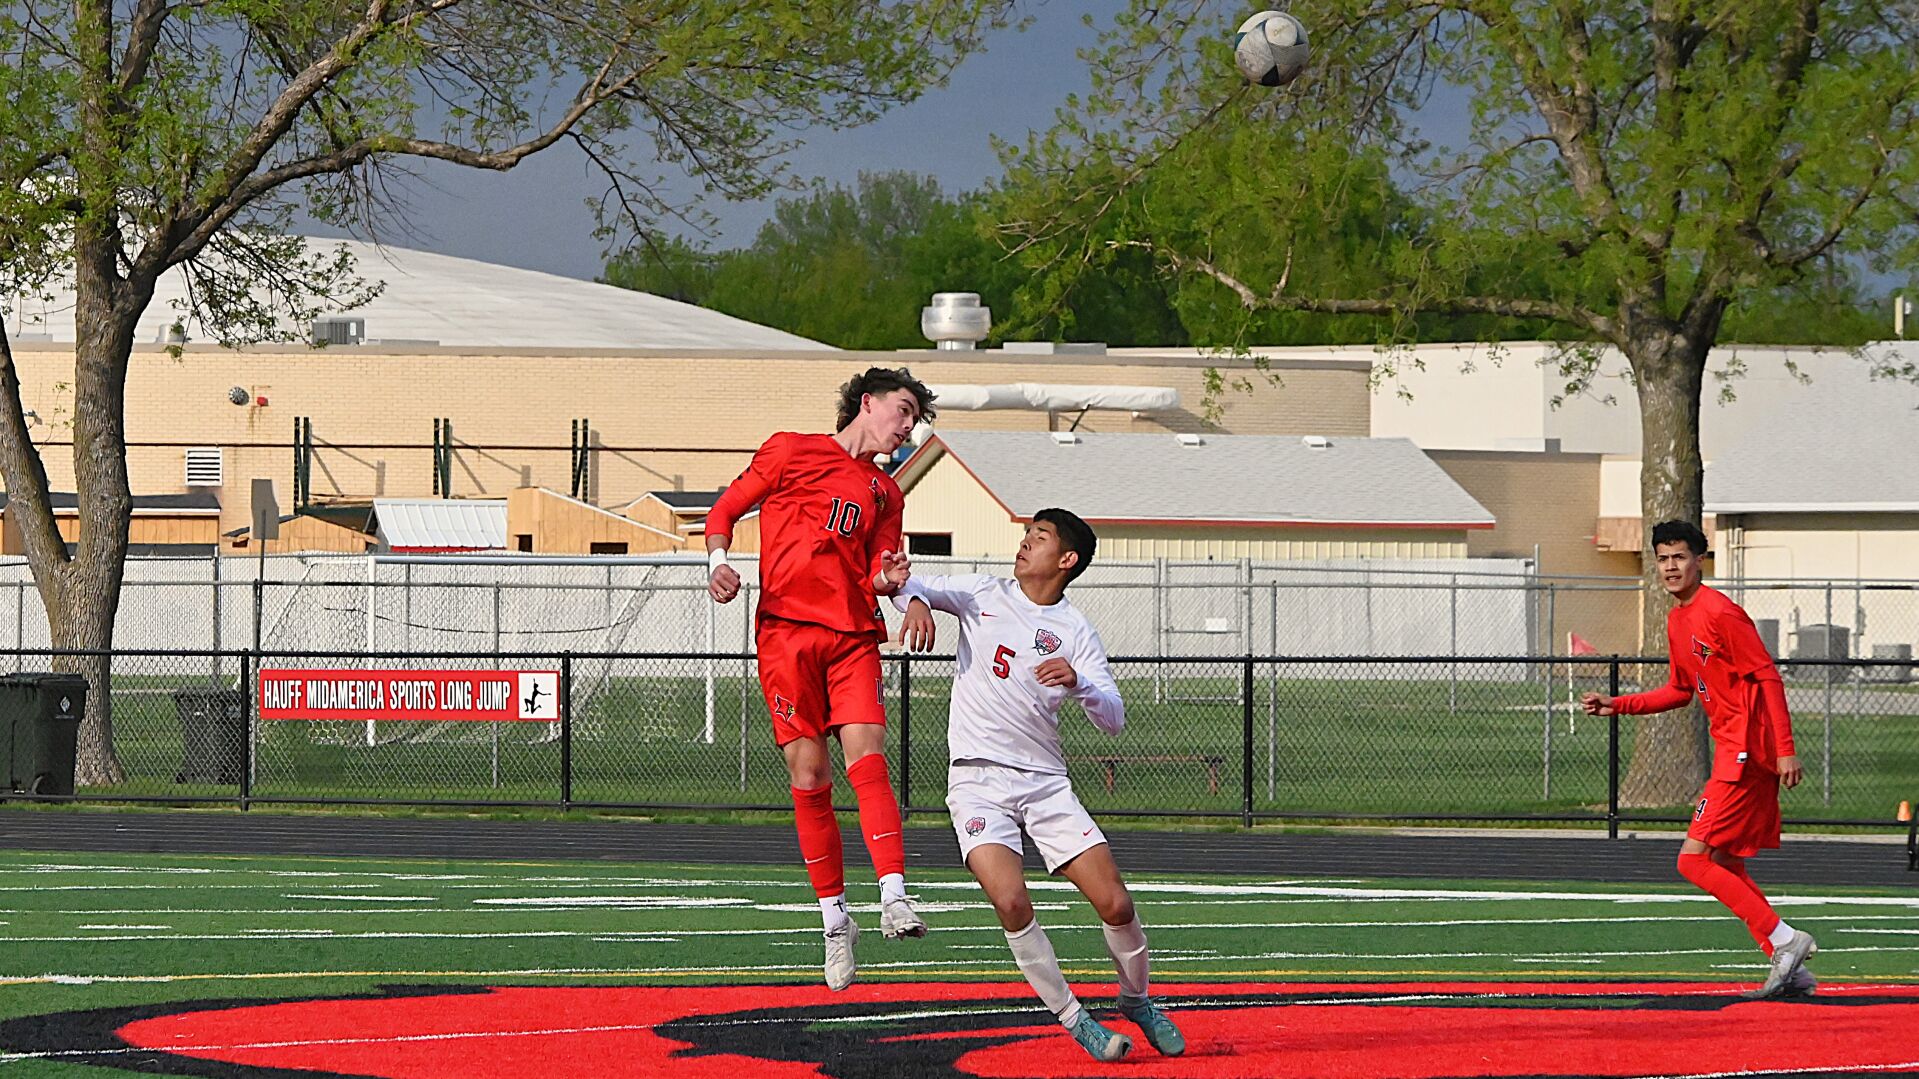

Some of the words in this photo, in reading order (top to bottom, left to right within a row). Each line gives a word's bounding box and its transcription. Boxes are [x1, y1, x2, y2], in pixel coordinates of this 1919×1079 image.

[825, 497, 862, 538] 10
[992, 644, 1017, 680] 5
[264, 680, 302, 709] HAUFF
[306, 680, 385, 710] MIDAMERICA
[389, 680, 436, 710] SPORTS
[440, 681, 472, 710] LONG
[476, 681, 511, 711] JUMP
[1695, 671, 1710, 702] 4
[1695, 798, 1708, 821] 4
